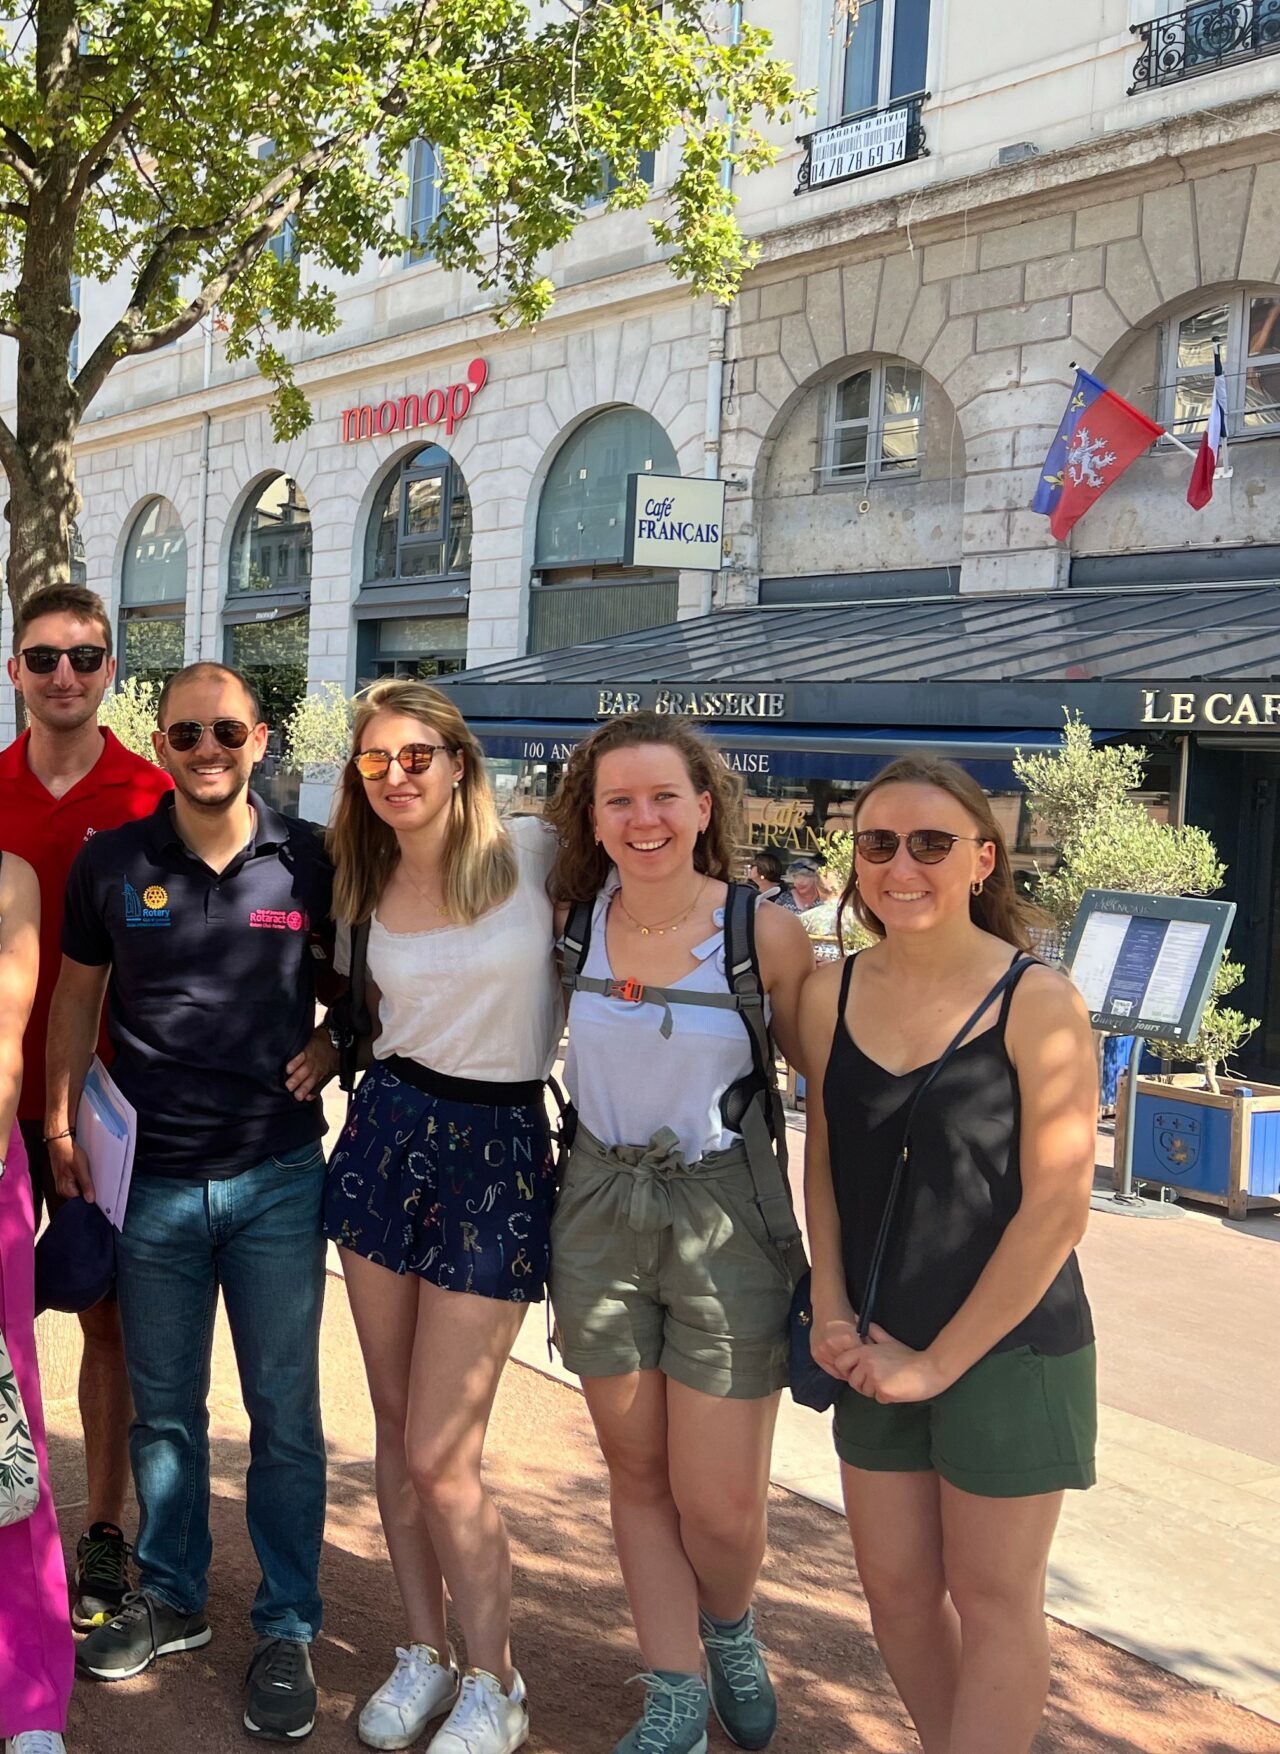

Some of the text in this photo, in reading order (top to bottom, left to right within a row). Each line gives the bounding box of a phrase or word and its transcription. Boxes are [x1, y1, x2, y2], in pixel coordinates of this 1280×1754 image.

[811, 161, 826, 183] 04
[848, 151, 863, 173] 28
[868, 145, 884, 167] 69
[888, 139, 904, 162] 34
[645, 497, 675, 522] Café
[637, 519, 719, 544] FRANÇAIS
[597, 689, 785, 717] BAR BRASSERIE
[1140, 689, 1196, 724] LE
[523, 742, 545, 758] 100
[719, 753, 770, 773] NAISE
[249, 912, 287, 924] Rotaract
[1134, 1019, 1161, 1032] jours
